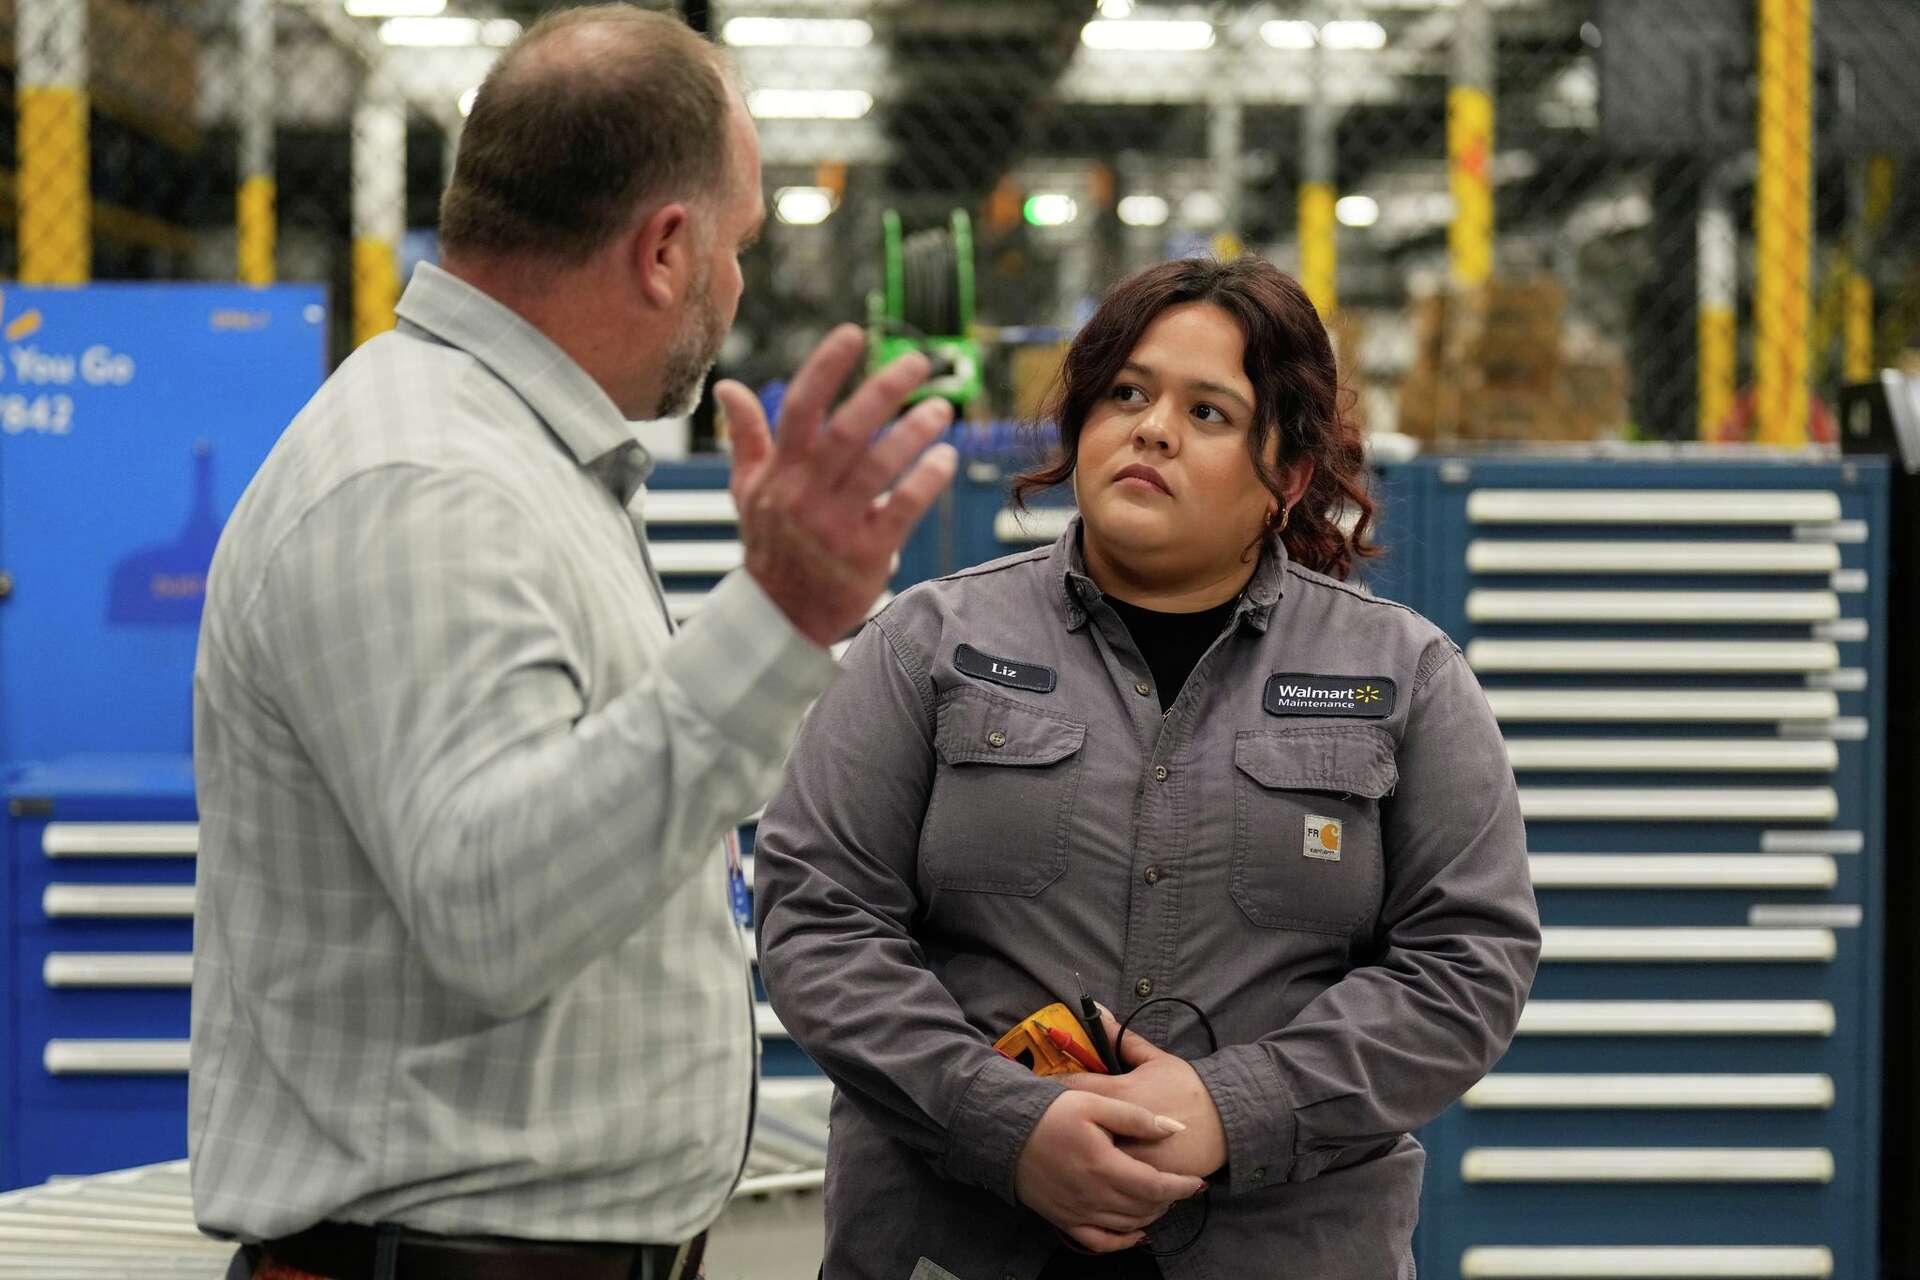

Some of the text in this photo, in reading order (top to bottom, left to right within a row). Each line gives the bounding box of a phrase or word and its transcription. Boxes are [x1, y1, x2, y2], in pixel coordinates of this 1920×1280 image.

[11, 346, 75, 384] You
[81, 345, 135, 385] Go
[991, 662, 1017, 678] Liz
[1279, 685, 1355, 700] Walmart
[1278, 698, 1355, 709] Maintenance
[1307, 828, 1319, 838] FR
